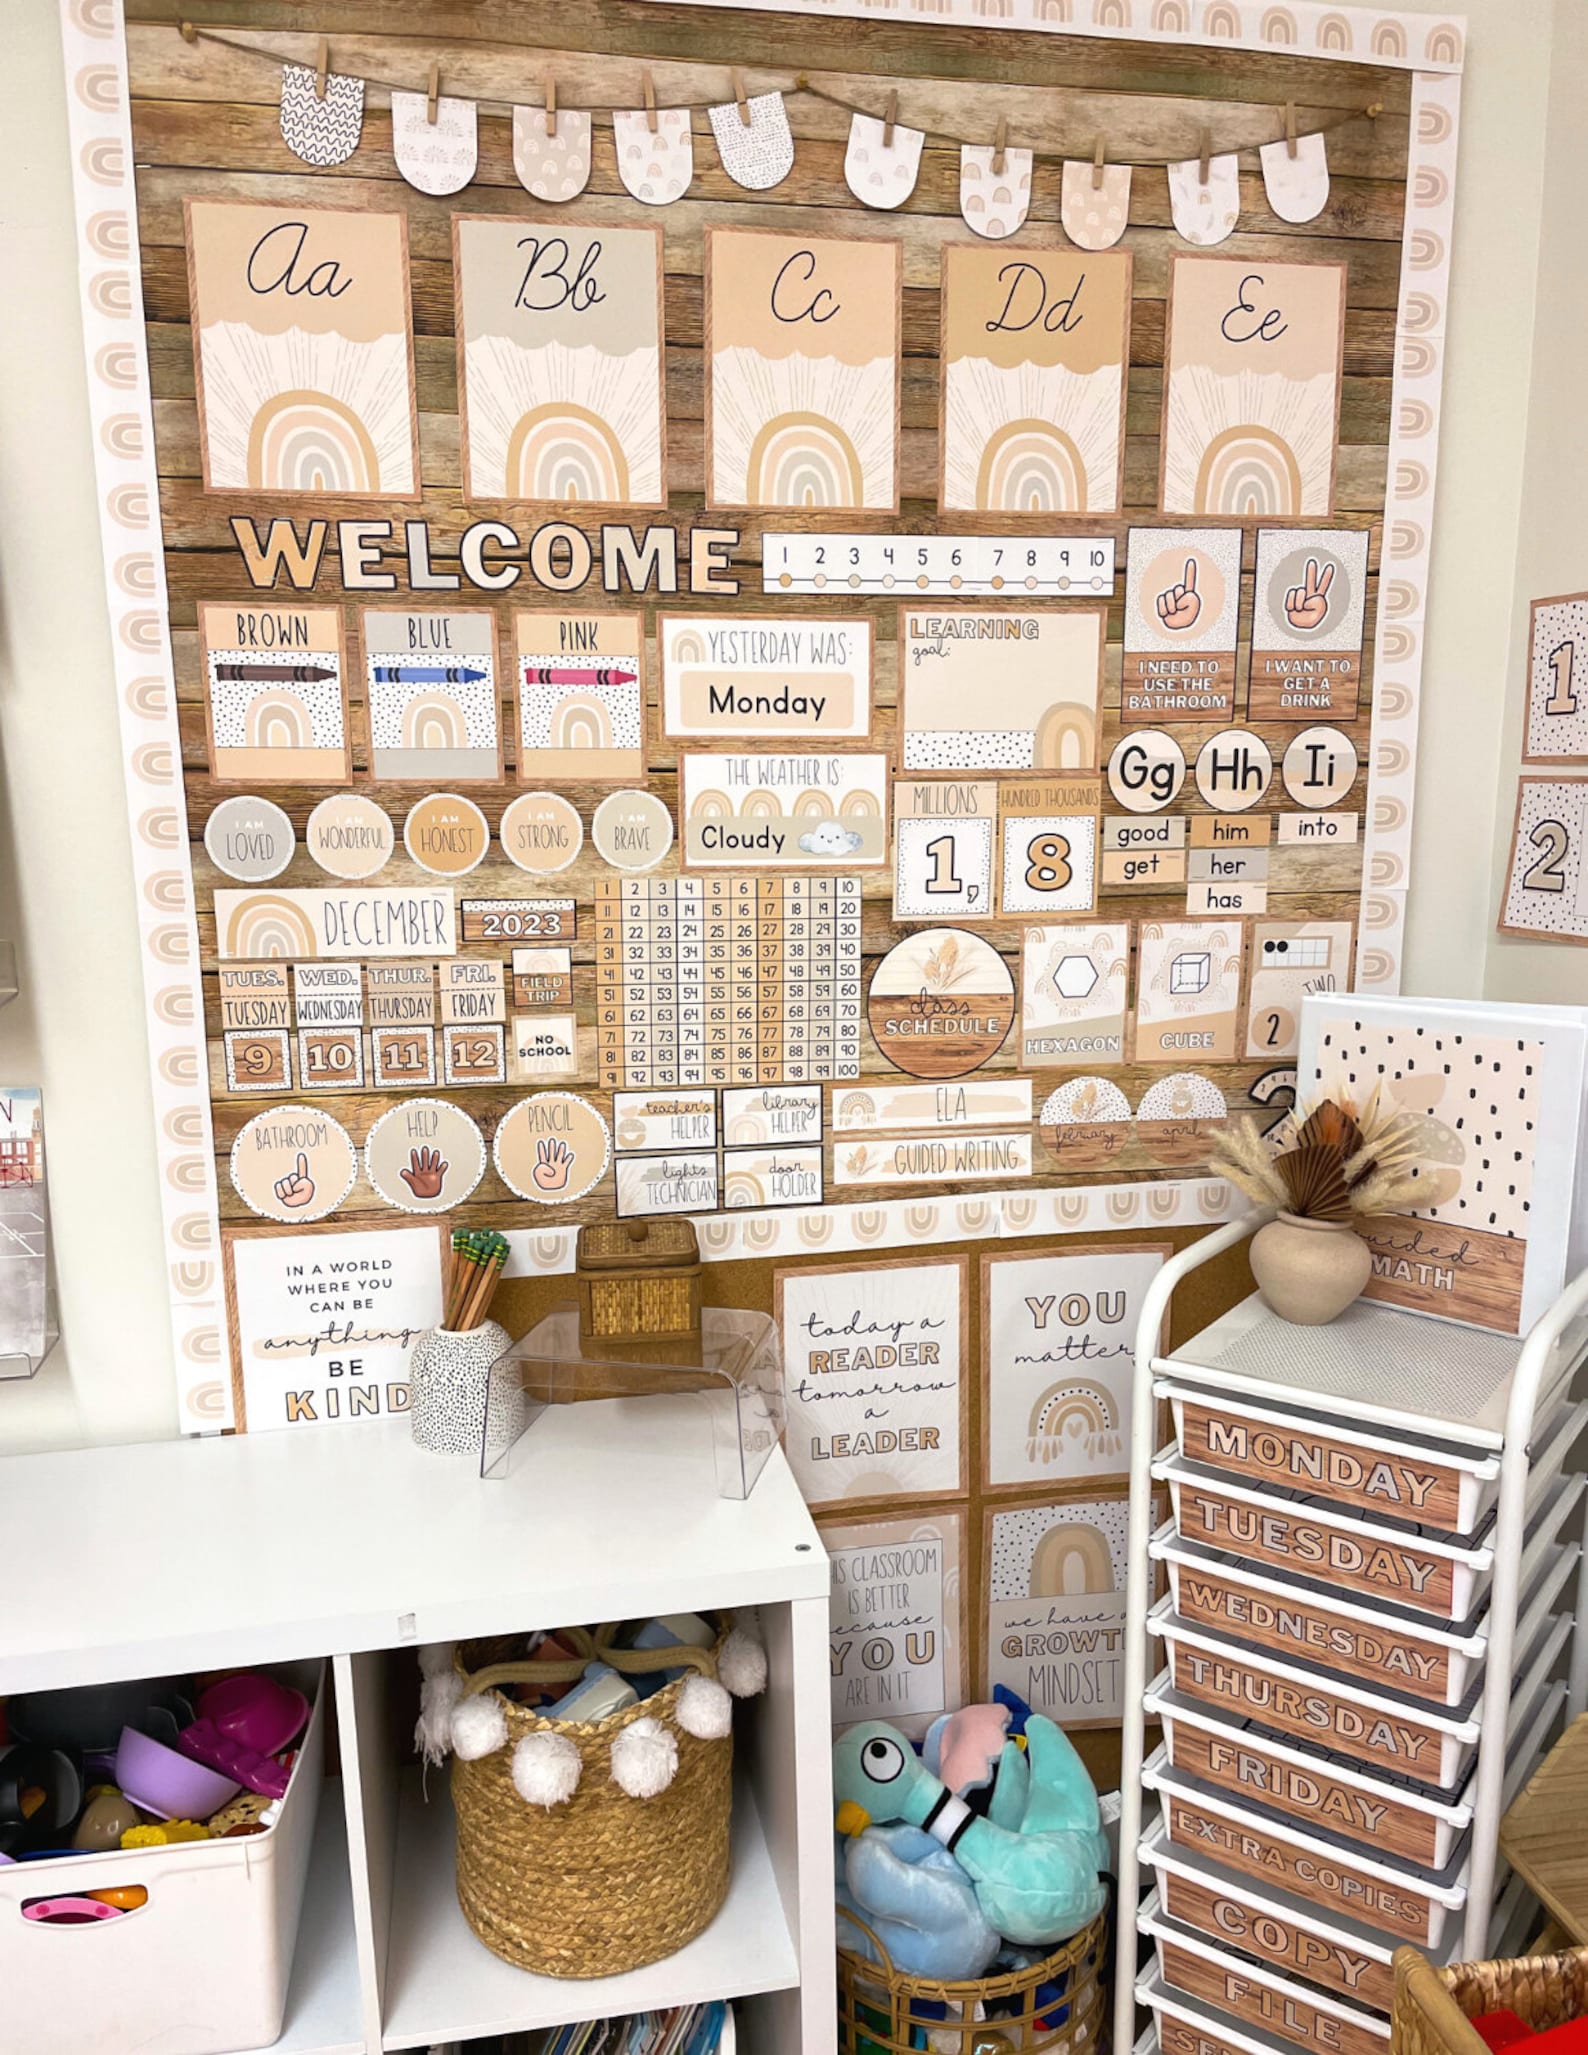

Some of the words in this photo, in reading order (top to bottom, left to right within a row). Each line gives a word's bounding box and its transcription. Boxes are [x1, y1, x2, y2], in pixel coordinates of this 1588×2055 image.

[247, 222, 352, 298] Aa
[514, 237, 606, 311] Bb
[771, 251, 841, 323] Cc
[986, 262, 1085, 333] Dd
[1221, 274, 1288, 342] Ee
[230, 517, 739, 595] WELCOME
[782, 546, 788, 563] 1
[815, 547, 826, 565] 2
[848, 548, 860, 565] 3
[883, 548, 894, 565] 4
[917, 548, 928, 566] 5
[951, 549, 962, 566] 6
[993, 549, 1003, 566] 7
[1026, 550, 1036, 567] 8
[1060, 550, 1069, 567] 9
[1090, 550, 1105, 567] 10
[237, 613, 308, 648] BROWN
[408, 617, 452, 649] BLUE
[560, 620, 598, 652] PINK
[909, 618, 1041, 640] LEARNING
[707, 631, 802, 665] YESTERDAY
[810, 632, 854, 665] WAS:
[1138, 660, 1144, 673] I
[1147, 660, 1192, 674] NEED
[1197, 660, 1220, 673] TO
[1274, 659, 1323, 673] WANT
[1328, 659, 1352, 673] TO
[1545, 640, 1577, 716] 1
[1143, 677, 1176, 692] USE
[1181, 677, 1213, 692] THE
[1283, 676, 1316, 691] GET
[1318, 676, 1331, 691] A
[708, 685, 827, 721] Monday
[1128, 694, 1227, 710] BATHROOM
[1280, 693, 1332, 708] DRINK
[725, 758, 753, 787] THE
[758, 758, 820, 787] WEATHER
[1120, 745, 1175, 801] Gg
[1211, 747, 1263, 791] Hh
[1302, 743, 1336, 788] Ii
[912, 784, 979, 815] MILLIONS
[1001, 788, 1041, 808] HUNDRED
[1045, 787, 1100, 808] THOUSANDS
[318, 825, 386, 850] WONDERFUL
[421, 826, 474, 855] HONEST
[517, 823, 570, 850] STRONG
[613, 825, 652, 851] BRAVE
[700, 825, 786, 854] Cloudy
[1117, 819, 1170, 848] good
[1213, 819, 1250, 841] him
[1298, 818, 1338, 837] into
[226, 831, 276, 862] LOVED
[1522, 818, 1570, 893] 2
[1024, 832, 1073, 892] 8
[1123, 854, 1160, 880] get
[1210, 853, 1247, 875] her
[1206, 887, 1243, 909] has
[323, 899, 449, 946] DECEMBER
[481, 912, 562, 938] 2023
[603, 927, 614, 938] 21
[628, 927, 643, 939] 22
[656, 926, 672, 939] 23
[683, 925, 697, 937] 24
[710, 926, 725, 938] 25
[736, 925, 752, 937] 26
[762, 924, 777, 936] 27
[789, 923, 804, 935] 28
[815, 923, 831, 935] 29
[840, 923, 856, 935] 30
[222, 969, 285, 987] TUES.
[299, 969, 358, 987] WED.
[369, 967, 432, 984] THUR.
[450, 964, 496, 983] FRI.
[520, 975, 563, 989] FIELD
[1302, 973, 1337, 994] TWO
[298, 999, 362, 1021] WEDNESDAY
[369, 997, 433, 1020] THURSDAY
[451, 992, 497, 1017] FRIDAY
[525, 990, 560, 1002] TRIP
[910, 986, 973, 1019] class
[224, 1001, 287, 1026] TUESDAY
[884, 1017, 1000, 1036] SCHEDULE
[534, 1035, 555, 1045] NO
[1160, 1031, 1215, 1050] CUBE
[1266, 1013, 1281, 1046] 2
[243, 1044, 273, 1075] 9
[308, 1043, 354, 1071] 10
[384, 1042, 424, 1071] 11
[454, 1041, 496, 1069] 12
[518, 1046, 572, 1058] SCHOOL
[1026, 1036, 1121, 1055] HEXAGON
[528, 1103, 575, 1133] PENCIL
[645, 1099, 711, 1115] teacher's
[762, 1090, 818, 1120] library
[935, 1087, 967, 1122] ELA
[406, 1110, 438, 1138] HELP
[670, 1115, 710, 1140] HELPER
[771, 1109, 808, 1134] HELPER
[1162, 1120, 1202, 1146] april
[254, 1123, 329, 1151] BATHROOM
[769, 1155, 804, 1174] door
[894, 1143, 948, 1176] GUIDED
[956, 1139, 1020, 1173] WRITING
[662, 1159, 707, 1187] lights
[772, 1172, 816, 1199] HOLDER
[646, 1180, 717, 1206] TECHNICIAN
[1355, 1230, 1480, 1266] uided
[286, 1264, 304, 1277] IN
[312, 1264, 323, 1275] A
[330, 1259, 393, 1274] WORLD
[1371, 1253, 1455, 1292] MATH
[288, 1281, 351, 1296] WHERE
[357, 1278, 393, 1291] YOU
[310, 1300, 345, 1314] CAN
[353, 1298, 374, 1311] BE
[1025, 1290, 1126, 1330] YOU
[263, 1320, 423, 1357] anything
[800, 1310, 915, 1343] today
[919, 1316, 946, 1330] a
[329, 1359, 364, 1378] BE
[808, 1341, 941, 1375] READER
[285, 1382, 414, 1422] KIND
[792, 1378, 957, 1402] tomorrow
[864, 1407, 890, 1420] a
[811, 1427, 941, 1461] LEADER
[1207, 1419, 1438, 1508] MONDAY
[1195, 1496, 1437, 1593] TUESDAY
[852, 1548, 938, 1583] CLASSROOM
[848, 1588, 860, 1616] IS
[865, 1583, 911, 1614] BETTER
[830, 1615, 934, 1636] ecause
[1004, 1617, 1042, 1629] we
[1047, 1606, 1116, 1626] have
[1186, 1580, 1439, 1682] WEDNESDAY
[830, 1630, 935, 1676] YOU
[1001, 1627, 1127, 1659] GROWT
[845, 1676, 870, 1707] ARE
[877, 1674, 892, 1704] IN
[897, 1671, 912, 1700] IT
[1029, 1659, 1121, 1706] MINDSET
[1185, 1653, 1429, 1760] THURSDAY
[1208, 1739, 1388, 1833] FRIDAY
[1177, 1809, 1288, 1872] EXTRA
[1294, 1858, 1424, 1925] COPIES
[1212, 1898, 1372, 1989] COPY
[1224, 1973, 1343, 2049] FILE
